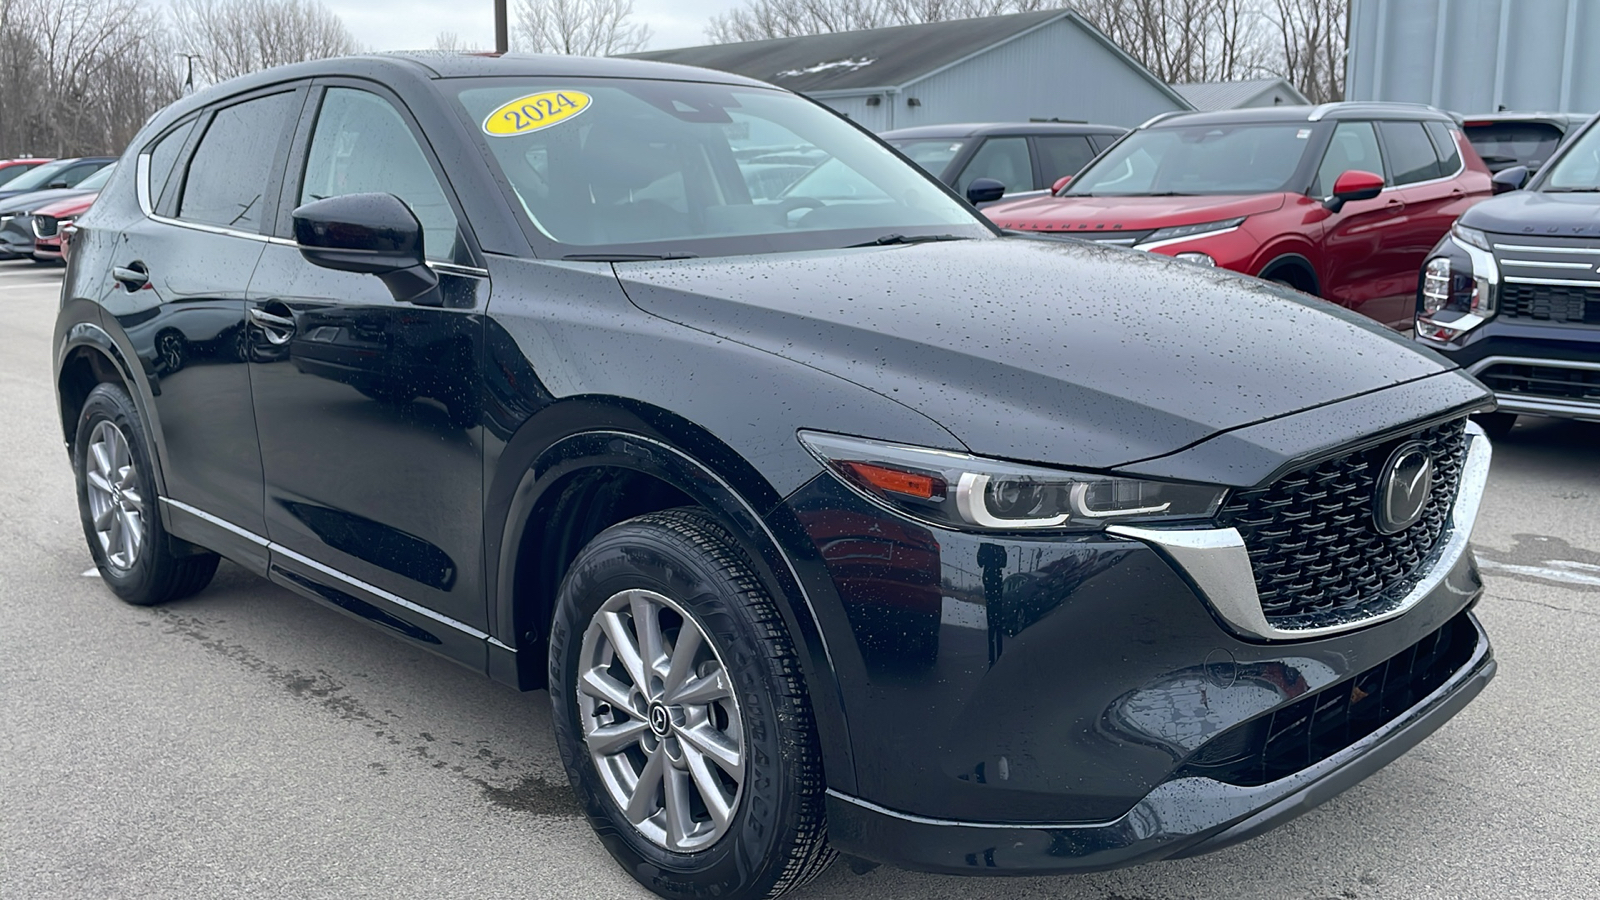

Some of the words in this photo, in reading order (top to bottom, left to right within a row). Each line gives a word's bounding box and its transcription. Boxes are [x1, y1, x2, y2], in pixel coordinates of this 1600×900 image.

[503, 93, 579, 130] 2024
[995, 222, 1123, 230] UTLANDER
[1521, 225, 1600, 233] OUT
